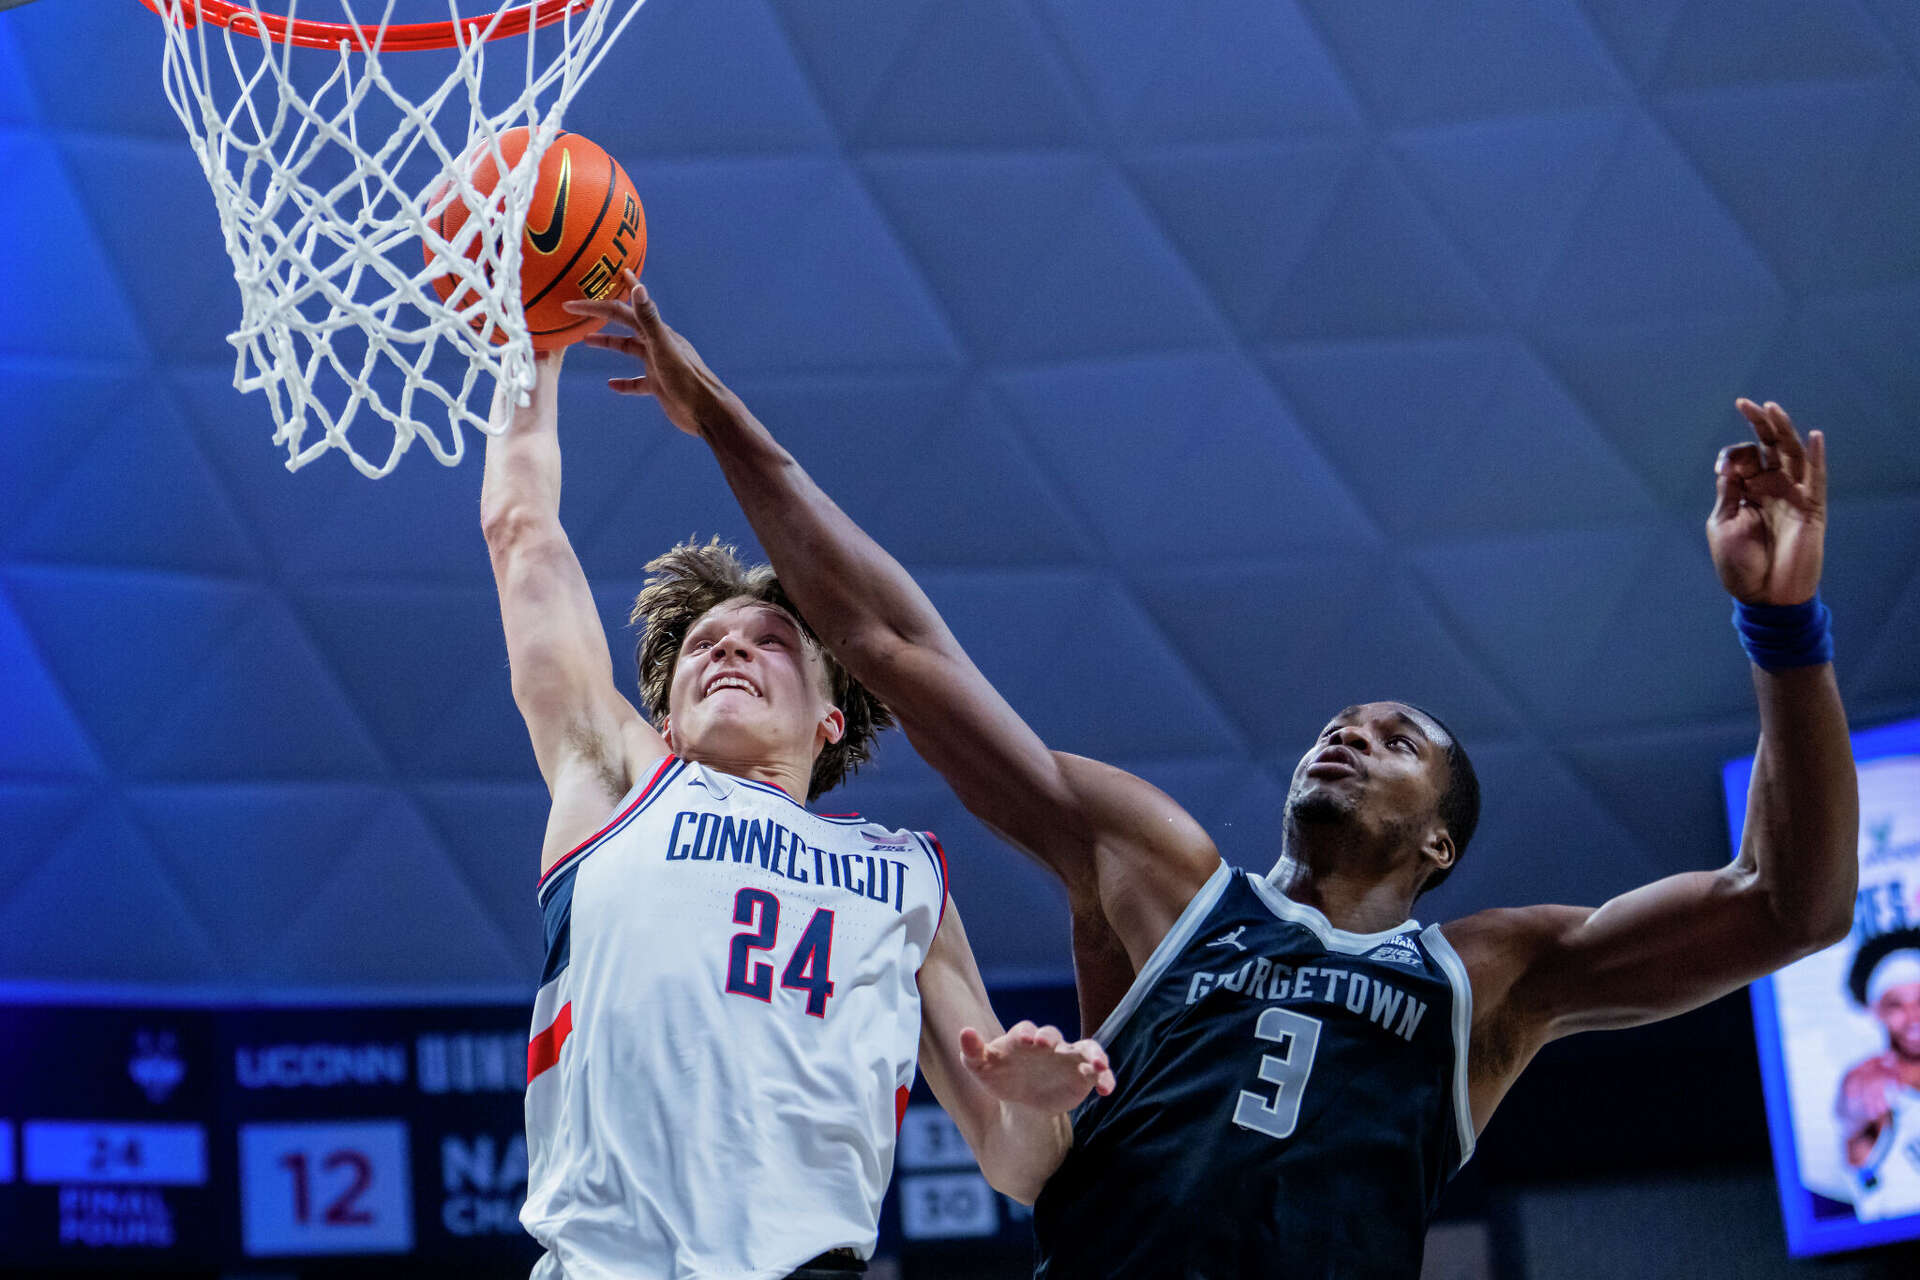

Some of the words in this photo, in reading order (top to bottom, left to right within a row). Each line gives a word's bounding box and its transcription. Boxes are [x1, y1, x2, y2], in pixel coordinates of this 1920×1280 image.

[578, 191, 641, 300] ELITE
[665, 811, 909, 913] CONNECTICUT
[725, 886, 835, 1018] 24
[235, 1043, 407, 1088] UCONN
[1232, 1007, 1323, 1139] 3
[89, 1134, 141, 1170] 24
[280, 1147, 375, 1227] 12
